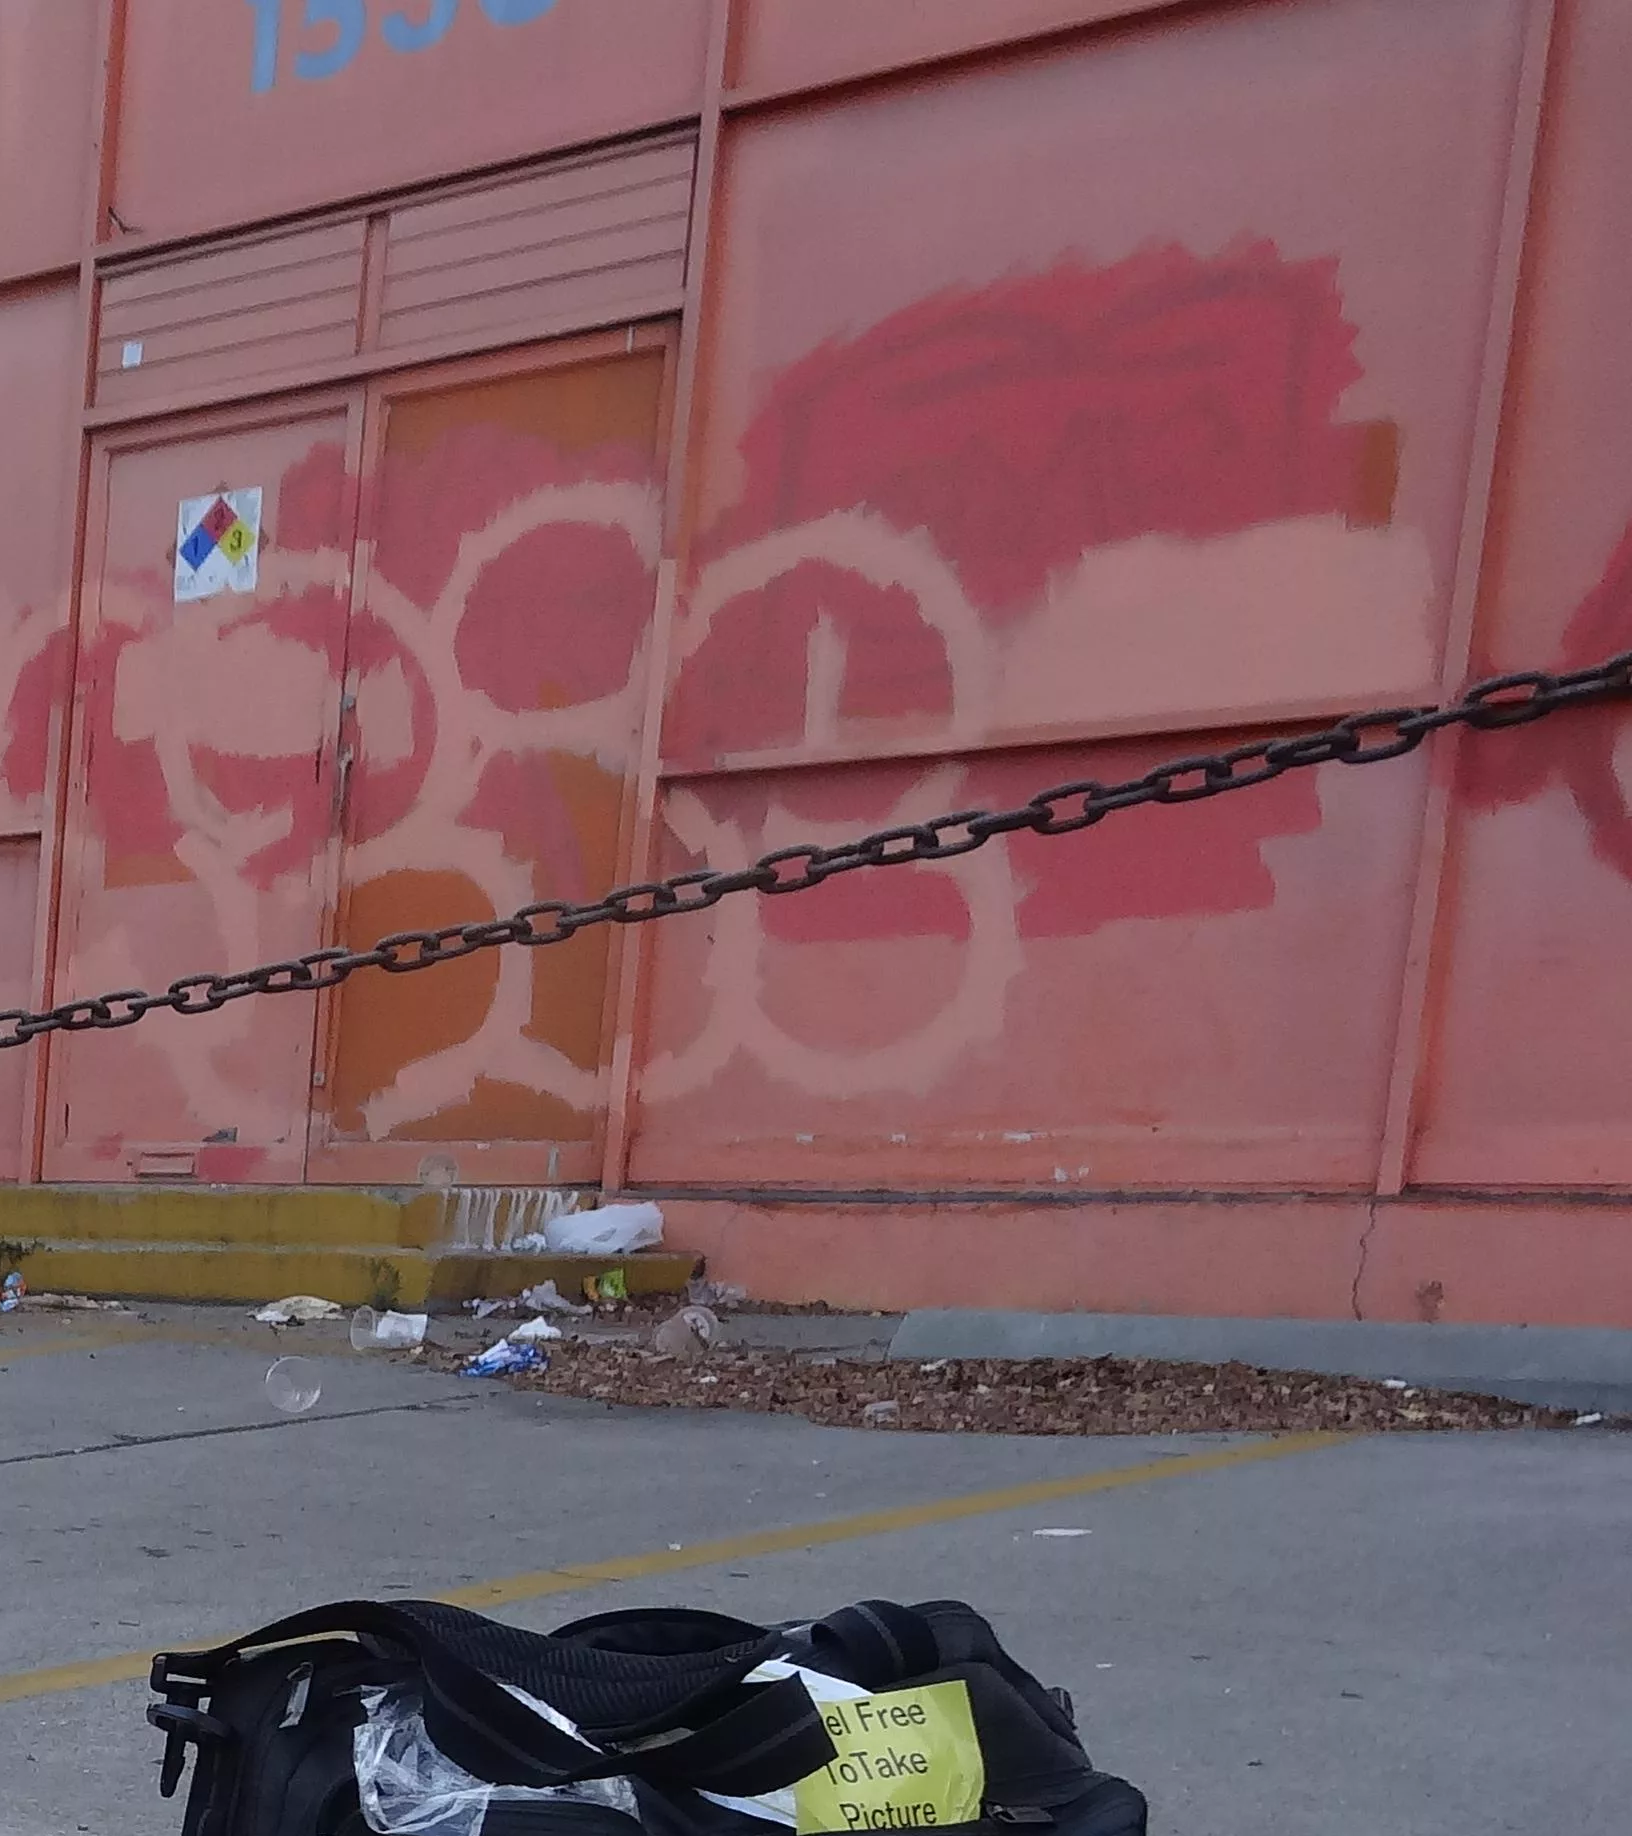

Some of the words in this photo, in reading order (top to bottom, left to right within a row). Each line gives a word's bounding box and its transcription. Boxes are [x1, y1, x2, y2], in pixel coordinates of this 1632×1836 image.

[191, 535, 199, 557] 1
[229, 529, 242, 551] 3
[825, 1705, 852, 1737] el
[855, 1702, 927, 1733] Free
[840, 1801, 938, 1830] Picture
